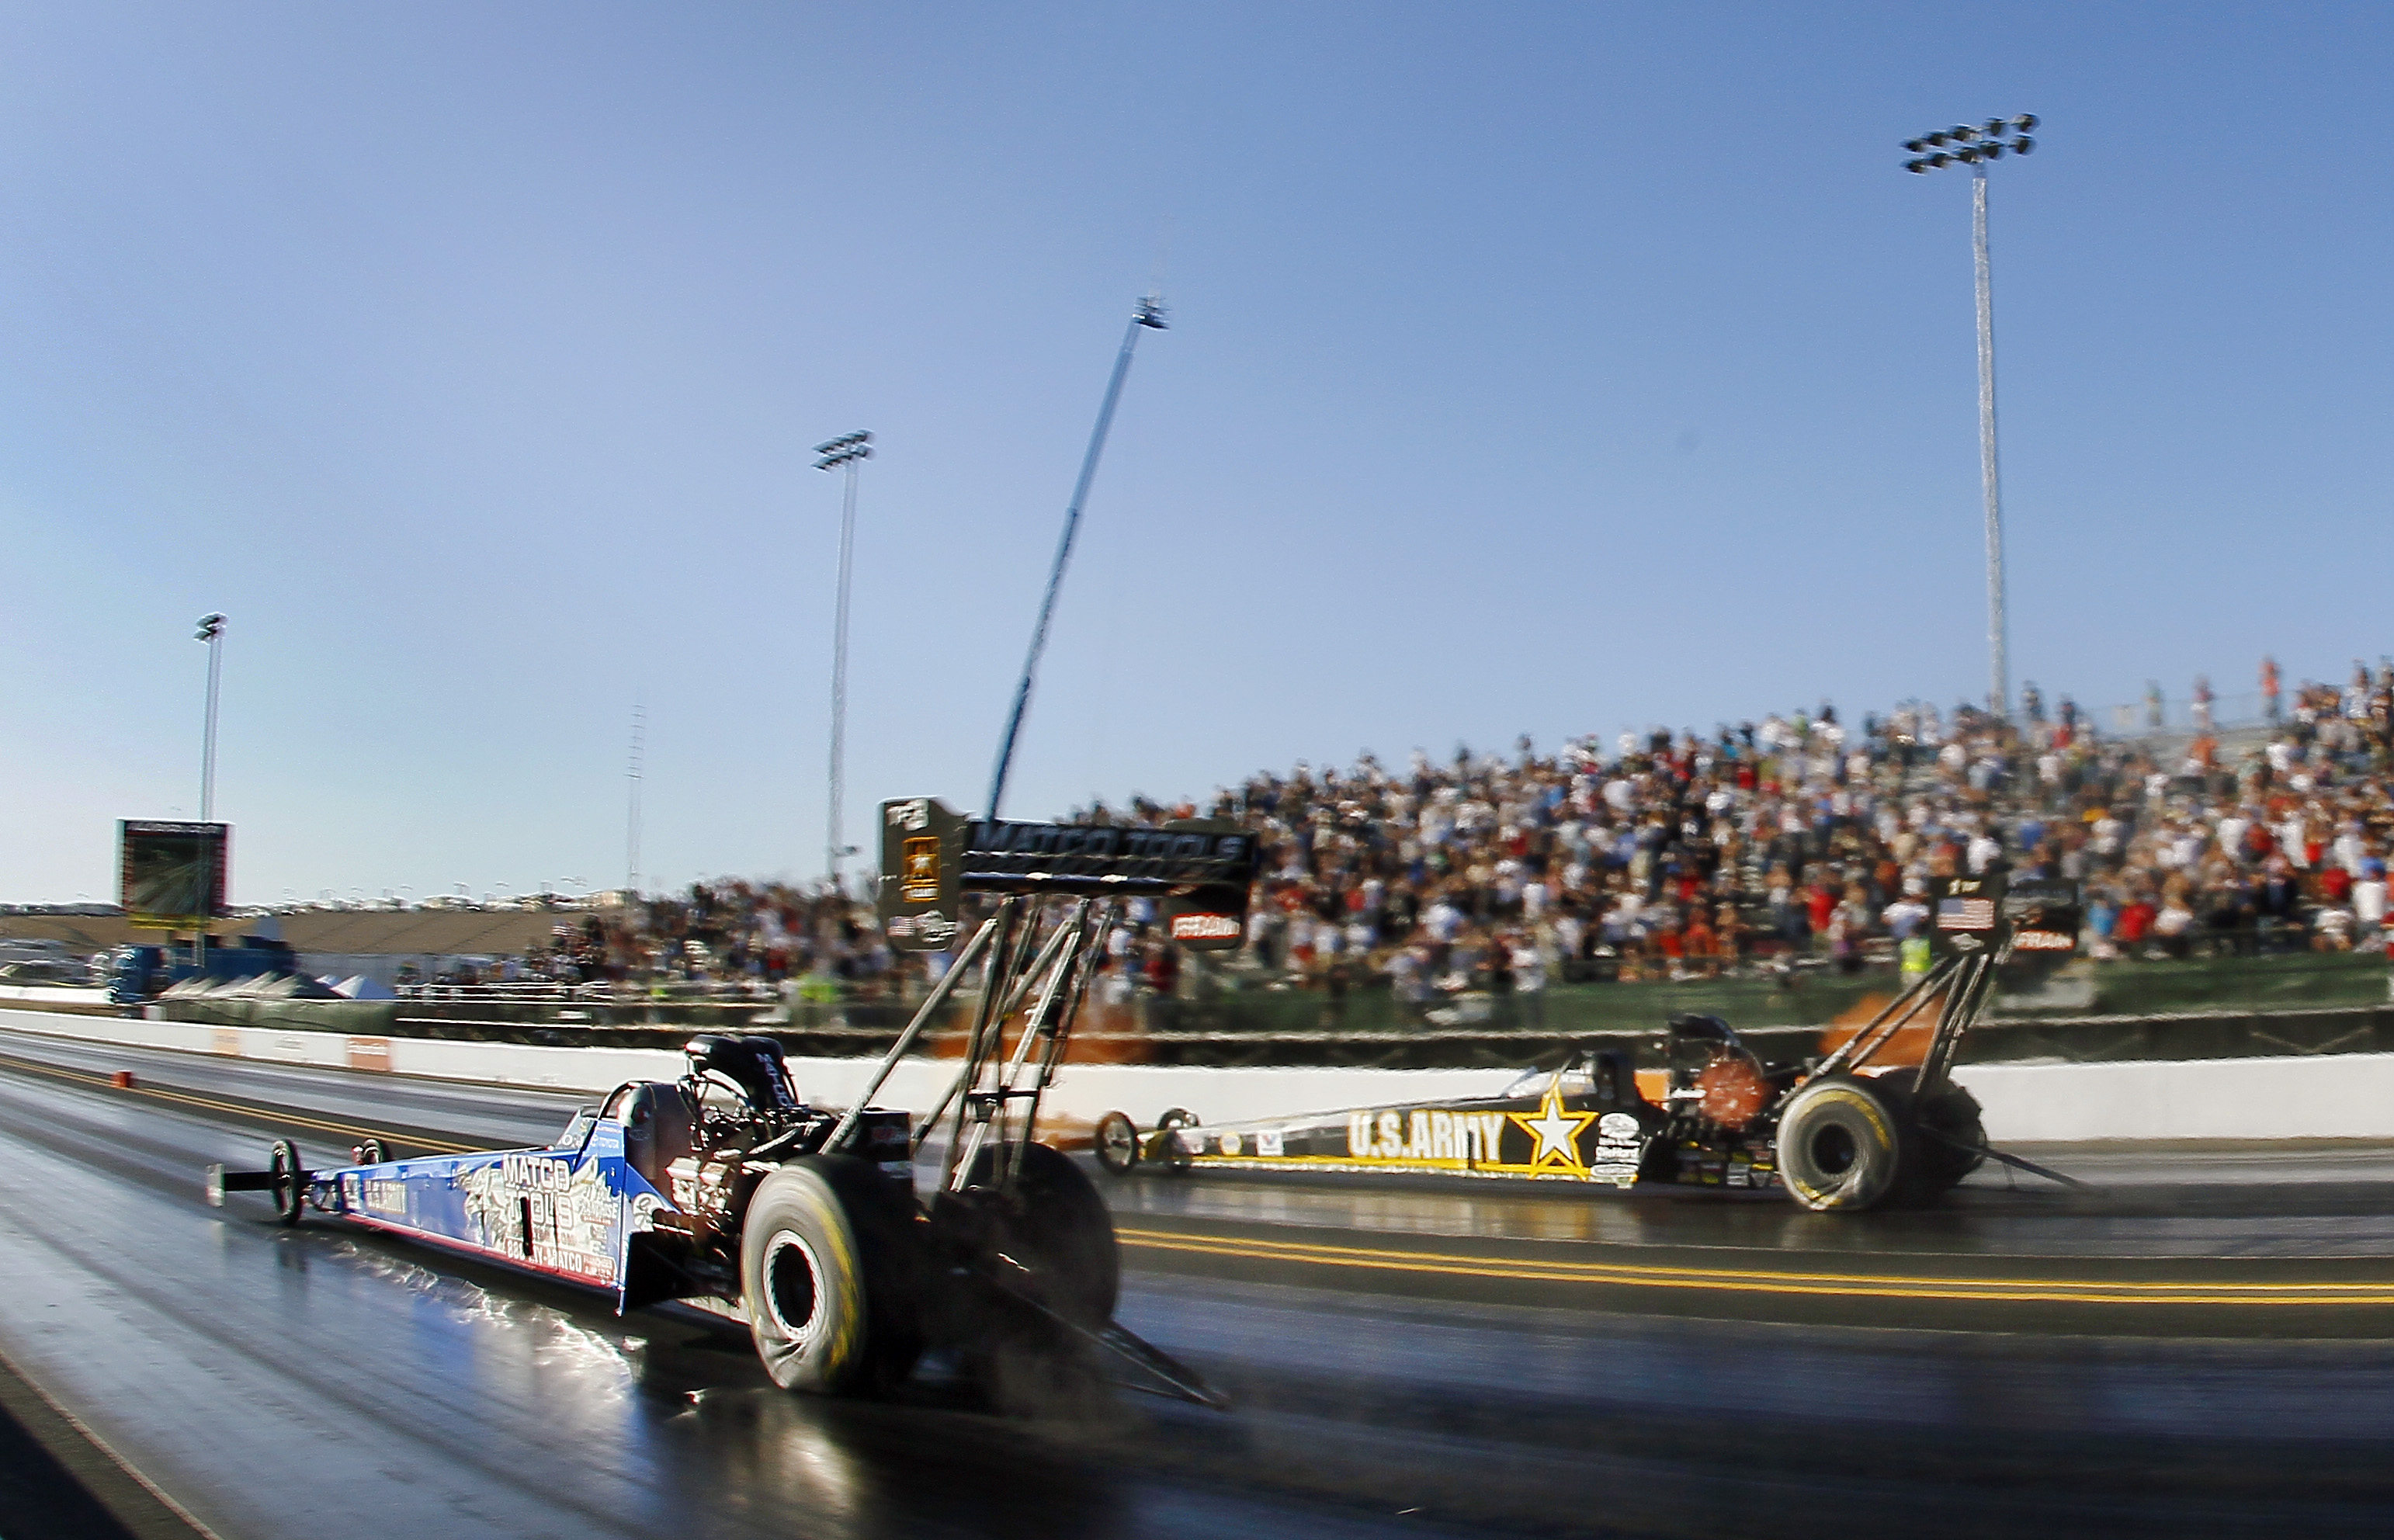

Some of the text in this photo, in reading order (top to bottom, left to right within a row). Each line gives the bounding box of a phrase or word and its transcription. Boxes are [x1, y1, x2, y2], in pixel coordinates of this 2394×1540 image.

[755, 1053, 796, 1108] MATCO
[503, 1154, 571, 1192] MATCO
[505, 1191, 574, 1230] TOLS
